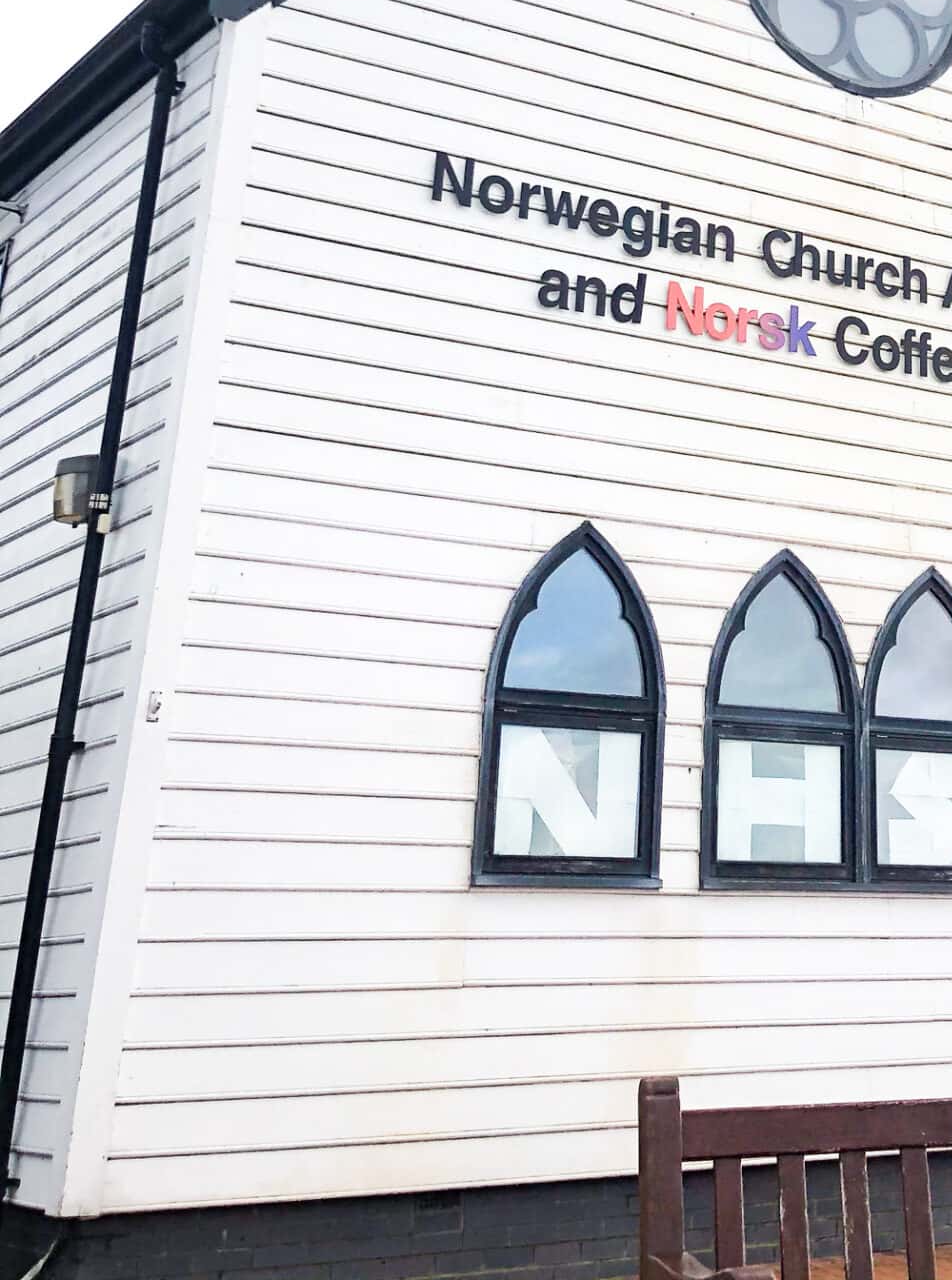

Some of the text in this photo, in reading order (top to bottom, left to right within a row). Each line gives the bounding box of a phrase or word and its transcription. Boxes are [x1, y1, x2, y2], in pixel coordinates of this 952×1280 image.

[431, 150, 735, 263] Norwegian
[763, 228, 929, 304] Church
[537, 268, 647, 325] and
[664, 280, 818, 357] Norsk
